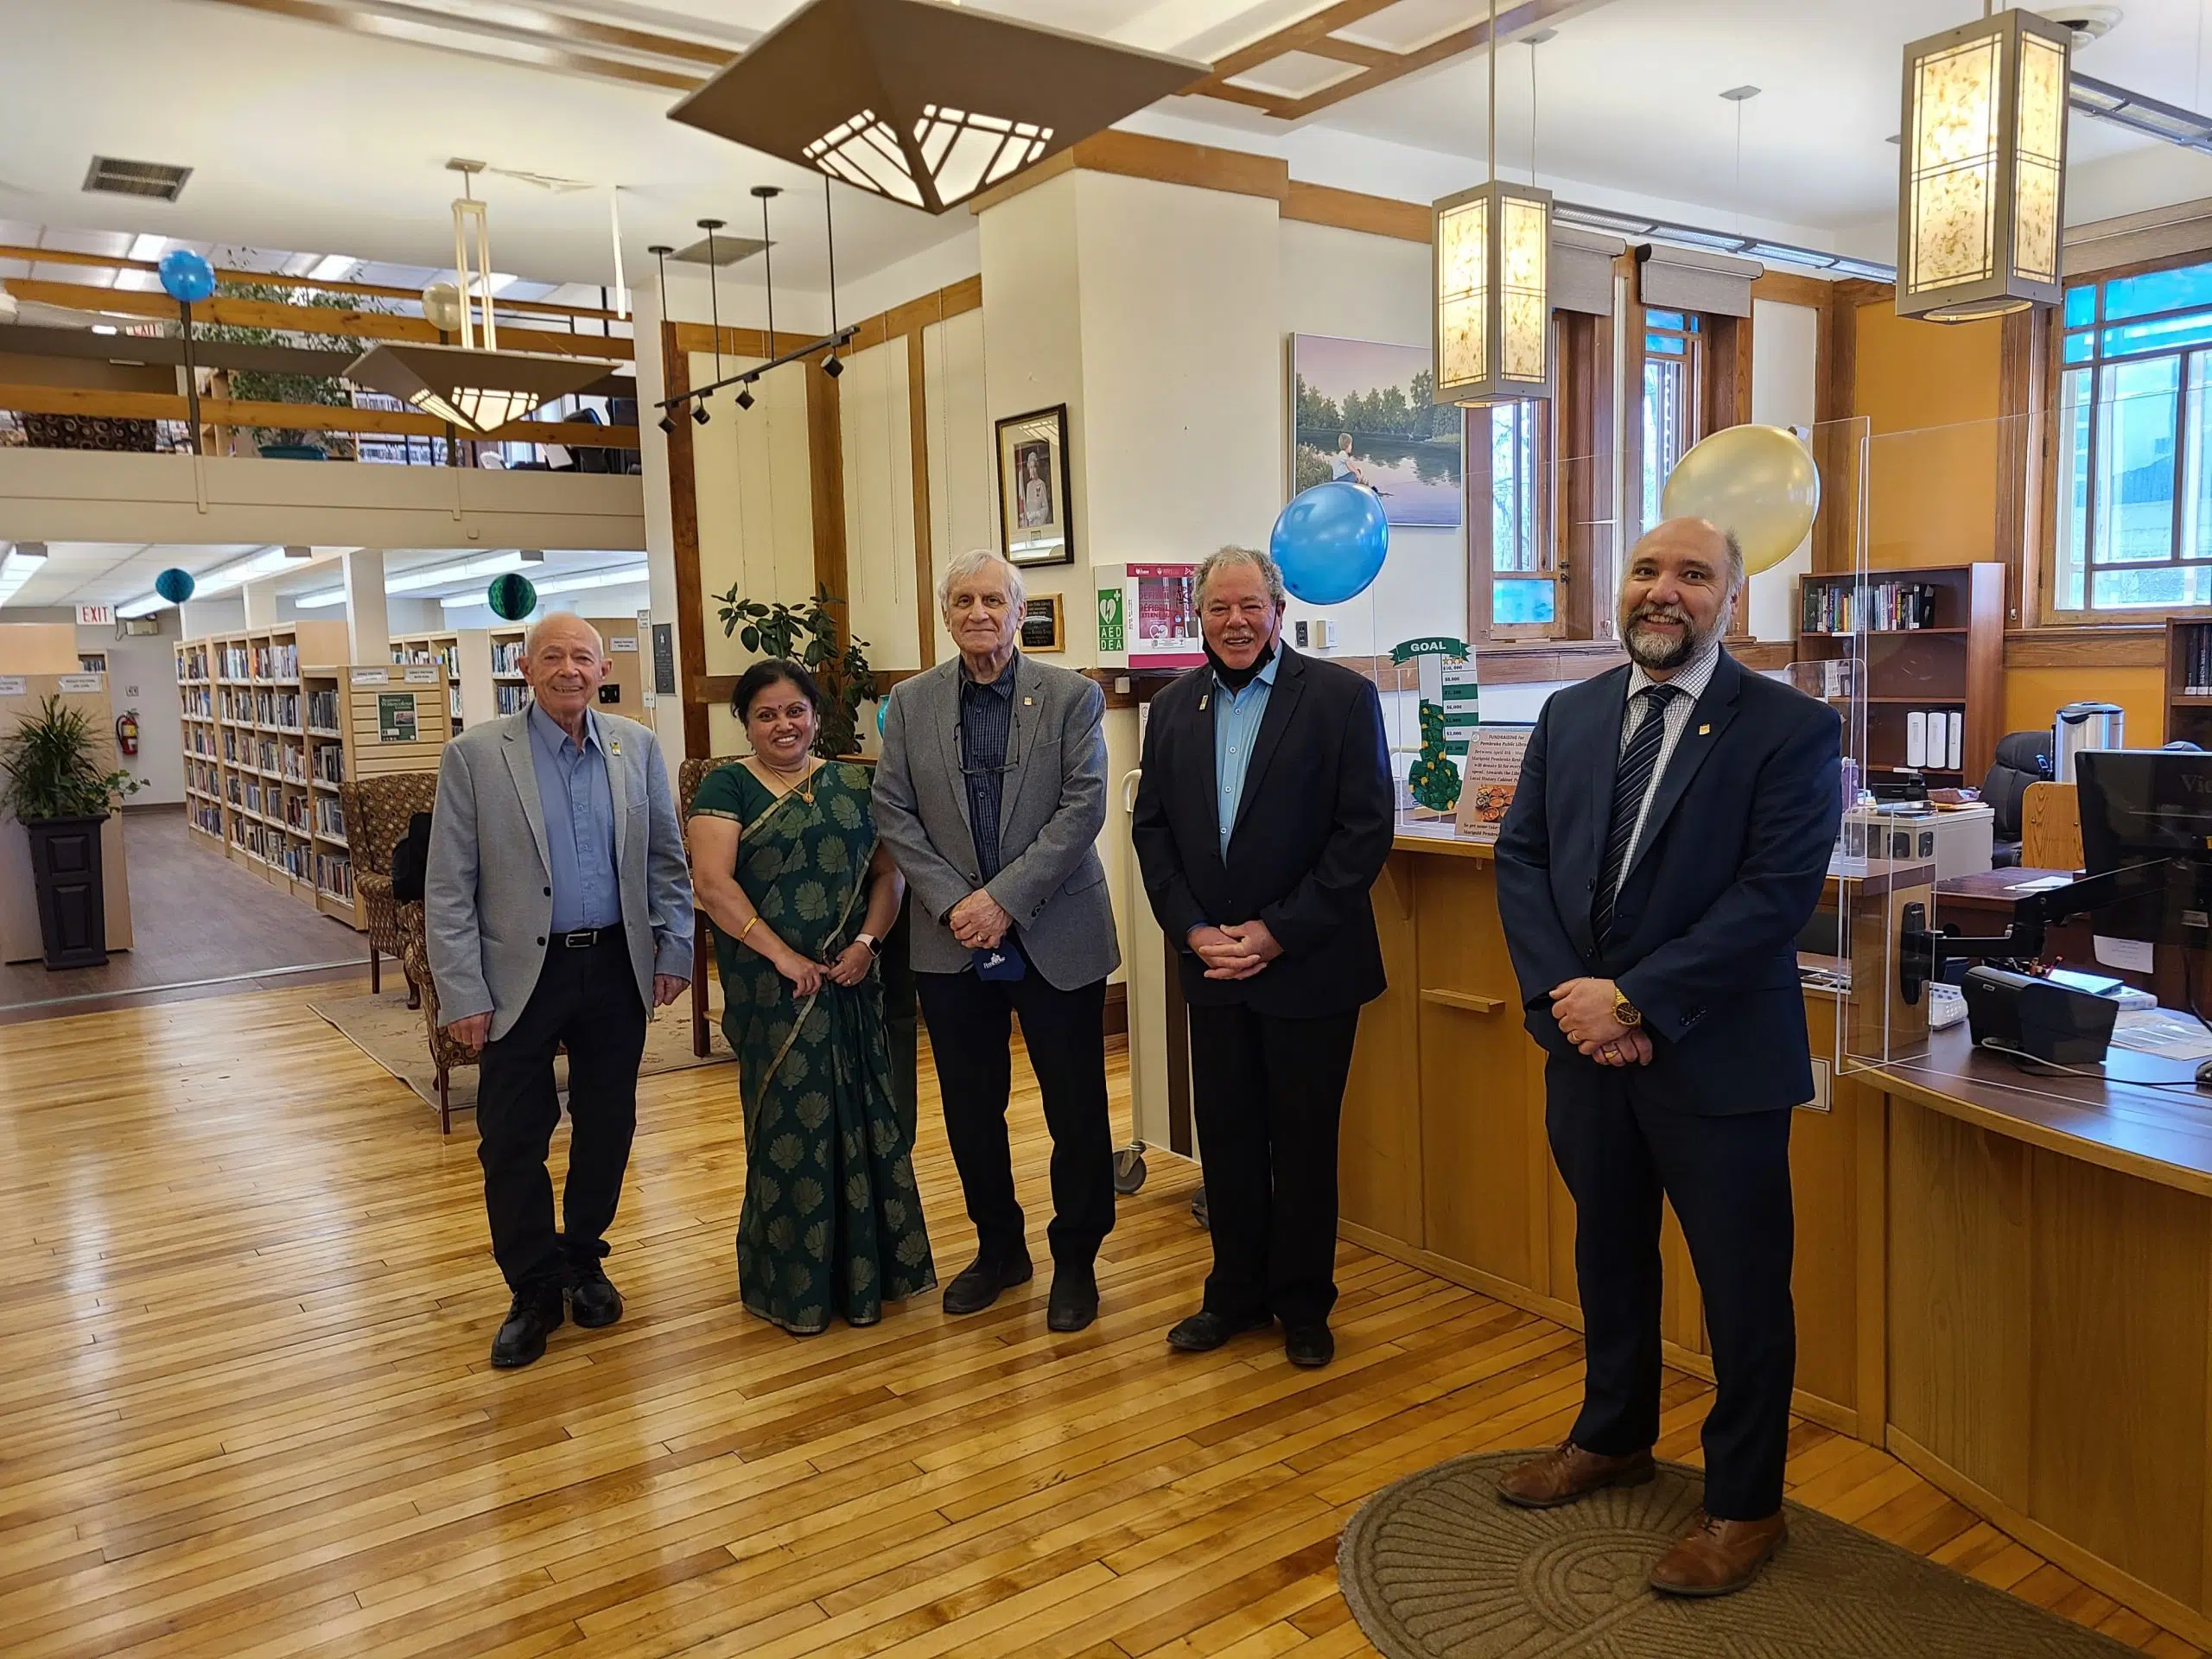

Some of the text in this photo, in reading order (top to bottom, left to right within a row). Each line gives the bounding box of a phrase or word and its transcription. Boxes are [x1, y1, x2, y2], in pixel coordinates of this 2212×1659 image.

[82, 606, 108, 622] EXIT
[1101, 626, 1122, 638] AED
[1101, 639, 1122, 651] DEA
[1410, 641, 1446, 652] GOAL
